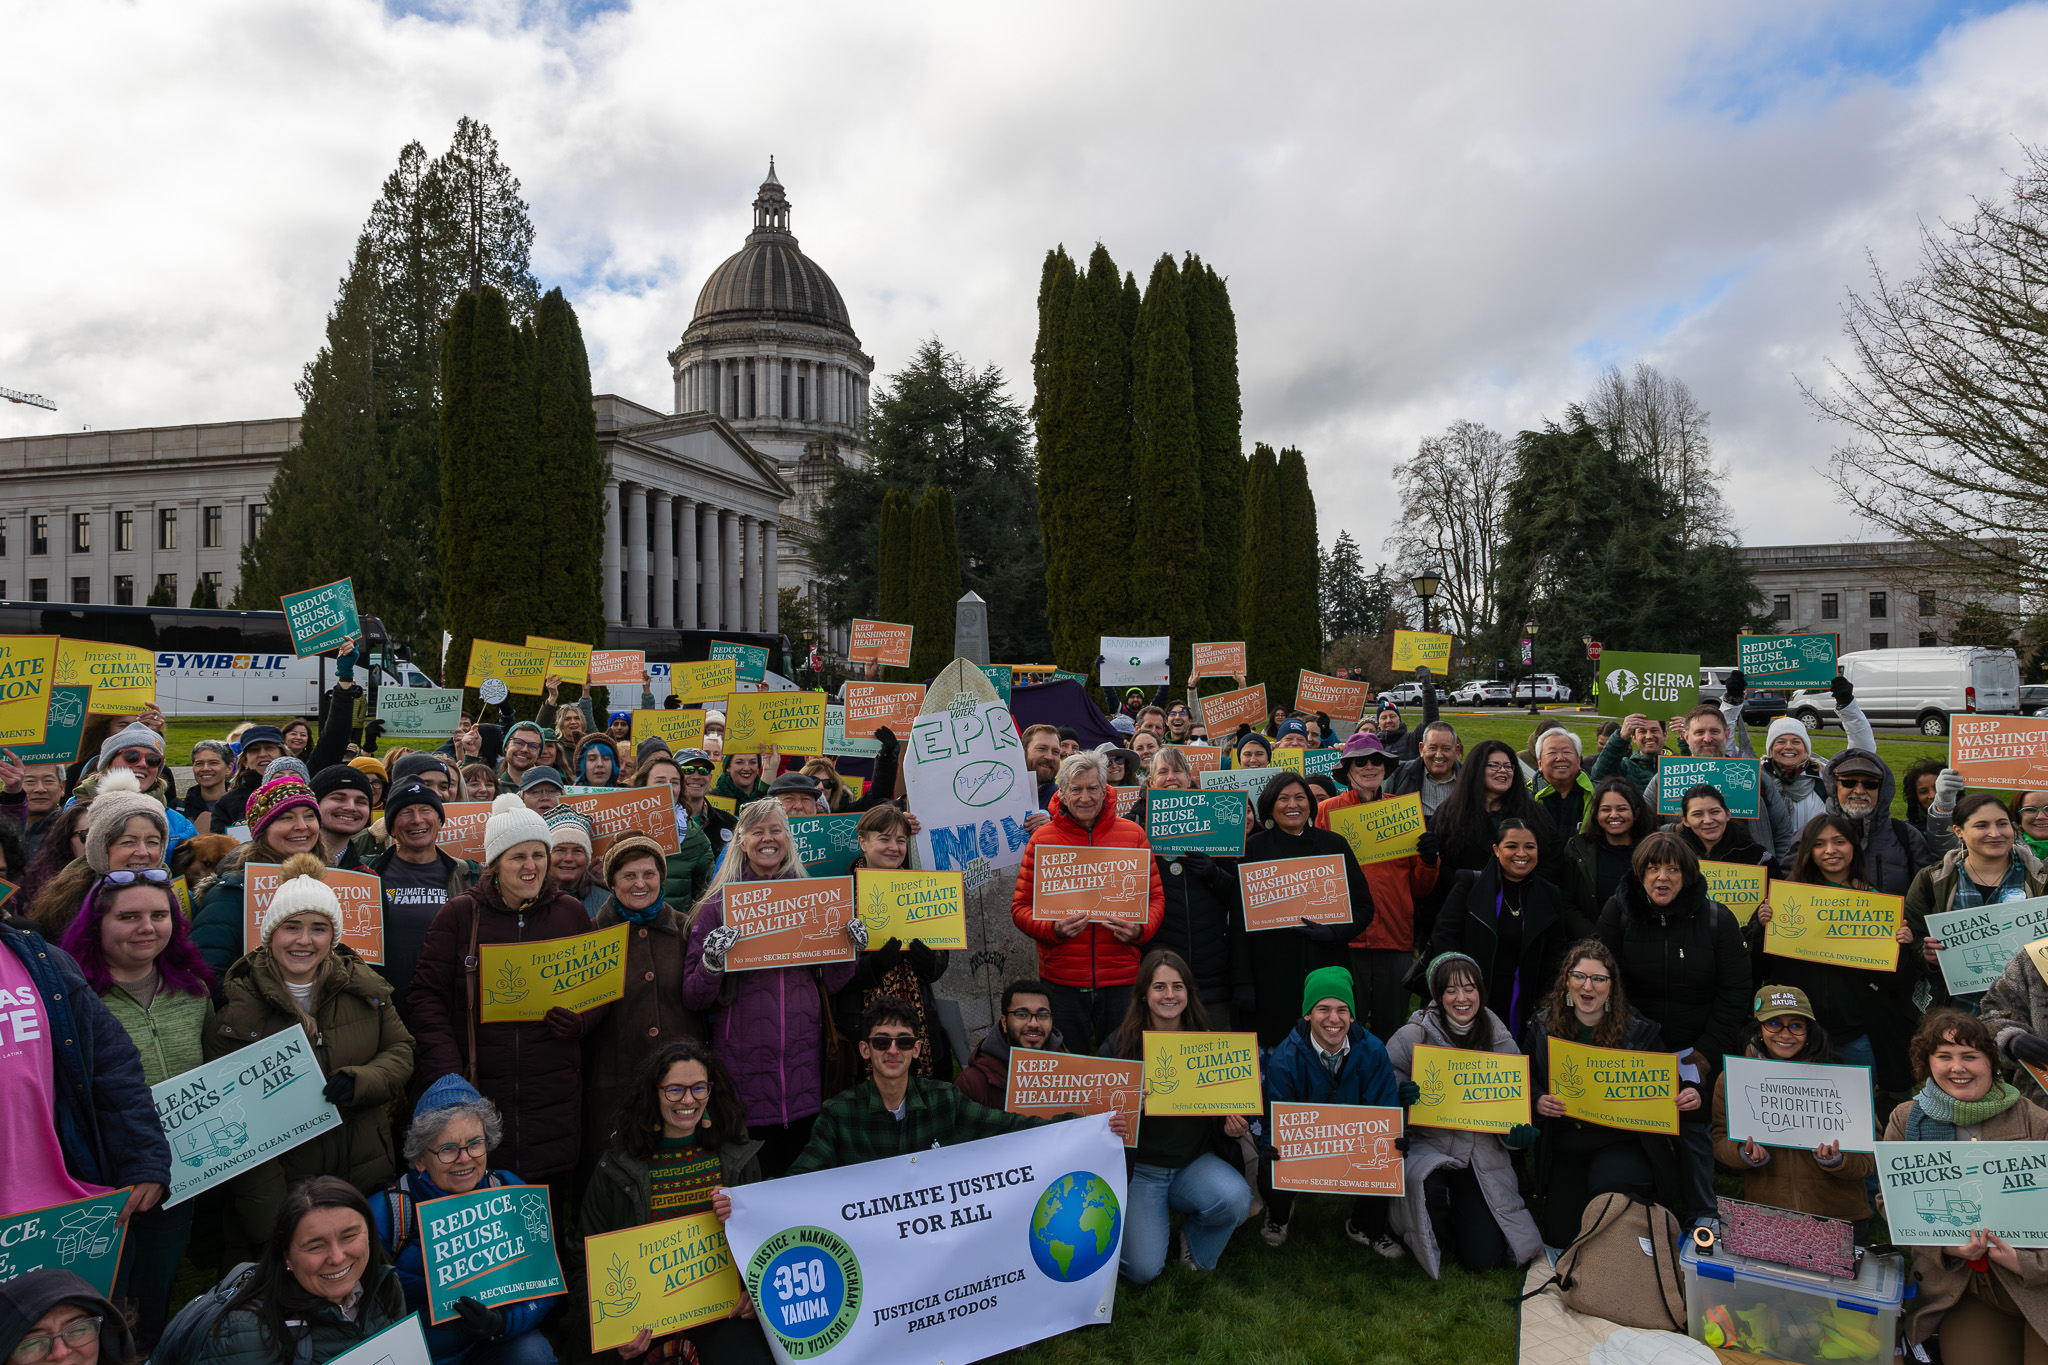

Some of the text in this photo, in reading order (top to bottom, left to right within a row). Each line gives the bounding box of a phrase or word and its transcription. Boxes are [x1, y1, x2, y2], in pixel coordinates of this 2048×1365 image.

[855, 630, 906, 639] WASHINGTON
[497, 650, 532, 658] Invest in
[1422, 650, 1448, 658] ACTION
[1742, 639, 1796, 653] REDUCE,
[157, 653, 289, 670] SYMBOLIC
[501, 658, 545, 666] CLIMATE
[1743, 651, 1786, 664] REUSE,
[232, 669, 286, 678] LINES
[505, 667, 543, 675] ACTION
[1744, 660, 1799, 674] RECYCLE
[1303, 676, 1324, 684] KEEP
[1643, 672, 1694, 688] SIERRA
[385, 693, 417, 701] CLEAN
[850, 686, 874, 697] KEEP
[850, 692, 917, 707] WASHINGTON
[1642, 687, 1679, 702] CLUB
[381, 695, 459, 709] TRUCKS CLEAN
[435, 704, 451, 712] AIR
[758, 696, 802, 710] Invest in
[763, 705, 820, 721] CLIMATE
[950, 706, 977, 719] VOTER!
[770, 717, 819, 731] ACTION
[1957, 721, 2000, 734] KEEP
[912, 706, 1018, 764] EPR
[1957, 731, 2048, 747] WASHINGT
[1664, 762, 1720, 775] REDUCE,
[1664, 774, 1708, 787] REUSE,
[1152, 795, 1209, 810] REDUCE,
[1152, 809, 1198, 823] REUSE,
[1359, 802, 1400, 822] Invest in
[1366, 805, 1418, 832] CLIMATE
[1151, 820, 1211, 837] RECYCLE
[1376, 818, 1420, 841] ACTION
[1041, 852, 1077, 866] KEEP
[1041, 859, 1138, 879] WASHINGTON
[1245, 866, 1278, 883] KEEP
[891, 877, 937, 892] Invest in
[966, 870, 992, 888] VOTER!
[1041, 875, 1107, 892] HEALTHY
[1247, 864, 1335, 893] WASHINGTON
[1707, 879, 1759, 890] LIMATE
[394, 895, 448, 905] FAMILIE
[395, 888, 448, 896] CLIMATE ACTIO
[731, 888, 772, 907] KEEP
[897, 887, 957, 906] CLIMATE
[1249, 882, 1309, 906] HEALTHY
[731, 888, 840, 922] WASHINGTON
[906, 901, 958, 920] ACTION
[1810, 896, 1870, 908] Invest in
[1817, 909, 1895, 923] CLIMATE
[1942, 913, 1991, 936] CLEAN
[1826, 924, 1893, 937] ACTION
[531, 940, 597, 966] Invest in
[540, 940, 620, 978] CLIMATE
[792, 951, 821, 959] SEWAGE
[823, 948, 848, 956] SPILLS!
[552, 955, 619, 992] ACTION
[1179, 1039, 1230, 1056] Invest in
[1016, 1060, 1058, 1072] KEEP
[1186, 1049, 1252, 1070] CLIMATE
[1448, 1058, 1498, 1071] Invest in
[1586, 1057, 1645, 1068] Invest in
[262, 1065, 295, 1094] AIR
[1016, 1072, 1130, 1088] WASHINGTON
[1196, 1064, 1252, 1085] ACTION
[1454, 1071, 1521, 1085] CLIMATE
[1594, 1069, 1670, 1083] CLIMATE
[155, 1077, 208, 1117] LEAN
[1014, 1090, 1092, 1104] HEALTHY
[1462, 1086, 1522, 1100] ACTION
[1604, 1085, 1670, 1098] ACTION
[1760, 1082, 1841, 1099] ENVIRONMENTAL
[1760, 1096, 1843, 1115] PRIORITIES
[1279, 1111, 1319, 1127] KEEP
[1578, 1108, 1599, 1118] Defend
[1617, 1117, 1670, 1128] INVESTMENTS
[1761, 1111, 1844, 1132] COALITION
[1280, 1119, 1390, 1142] WASHINGTON
[1280, 1138, 1355, 1158] HEALTHY
[1891, 1151, 1952, 1171] CLEAN
[1887, 1154, 2047, 1187] TRUCKS CLEAN
[2002, 1172, 2036, 1189] AIR
[841, 1165, 1035, 1222] CLIMATE JUSTICE
[430, 1194, 517, 1240] REDUCE,
[897, 1204, 992, 1240] FOR ALL
[434, 1220, 508, 1264] REUSE,
[638, 1223, 702, 1259] Invest in
[800, 1230, 848, 1259] NAKNÚWIT
[649, 1230, 726, 1275] CLIMATE
[436, 1236, 525, 1287] RECYCLE
[664, 1251, 729, 1293] ACTION
[776, 1259, 825, 1300] 350
[873, 1269, 1026, 1326] JUSTICIA CLIMÁTICA
[781, 1297, 829, 1326] YAKIMA
[907, 1295, 998, 1333] PARA TODOS
[808, 1318, 848, 1353] JUSTICIA
